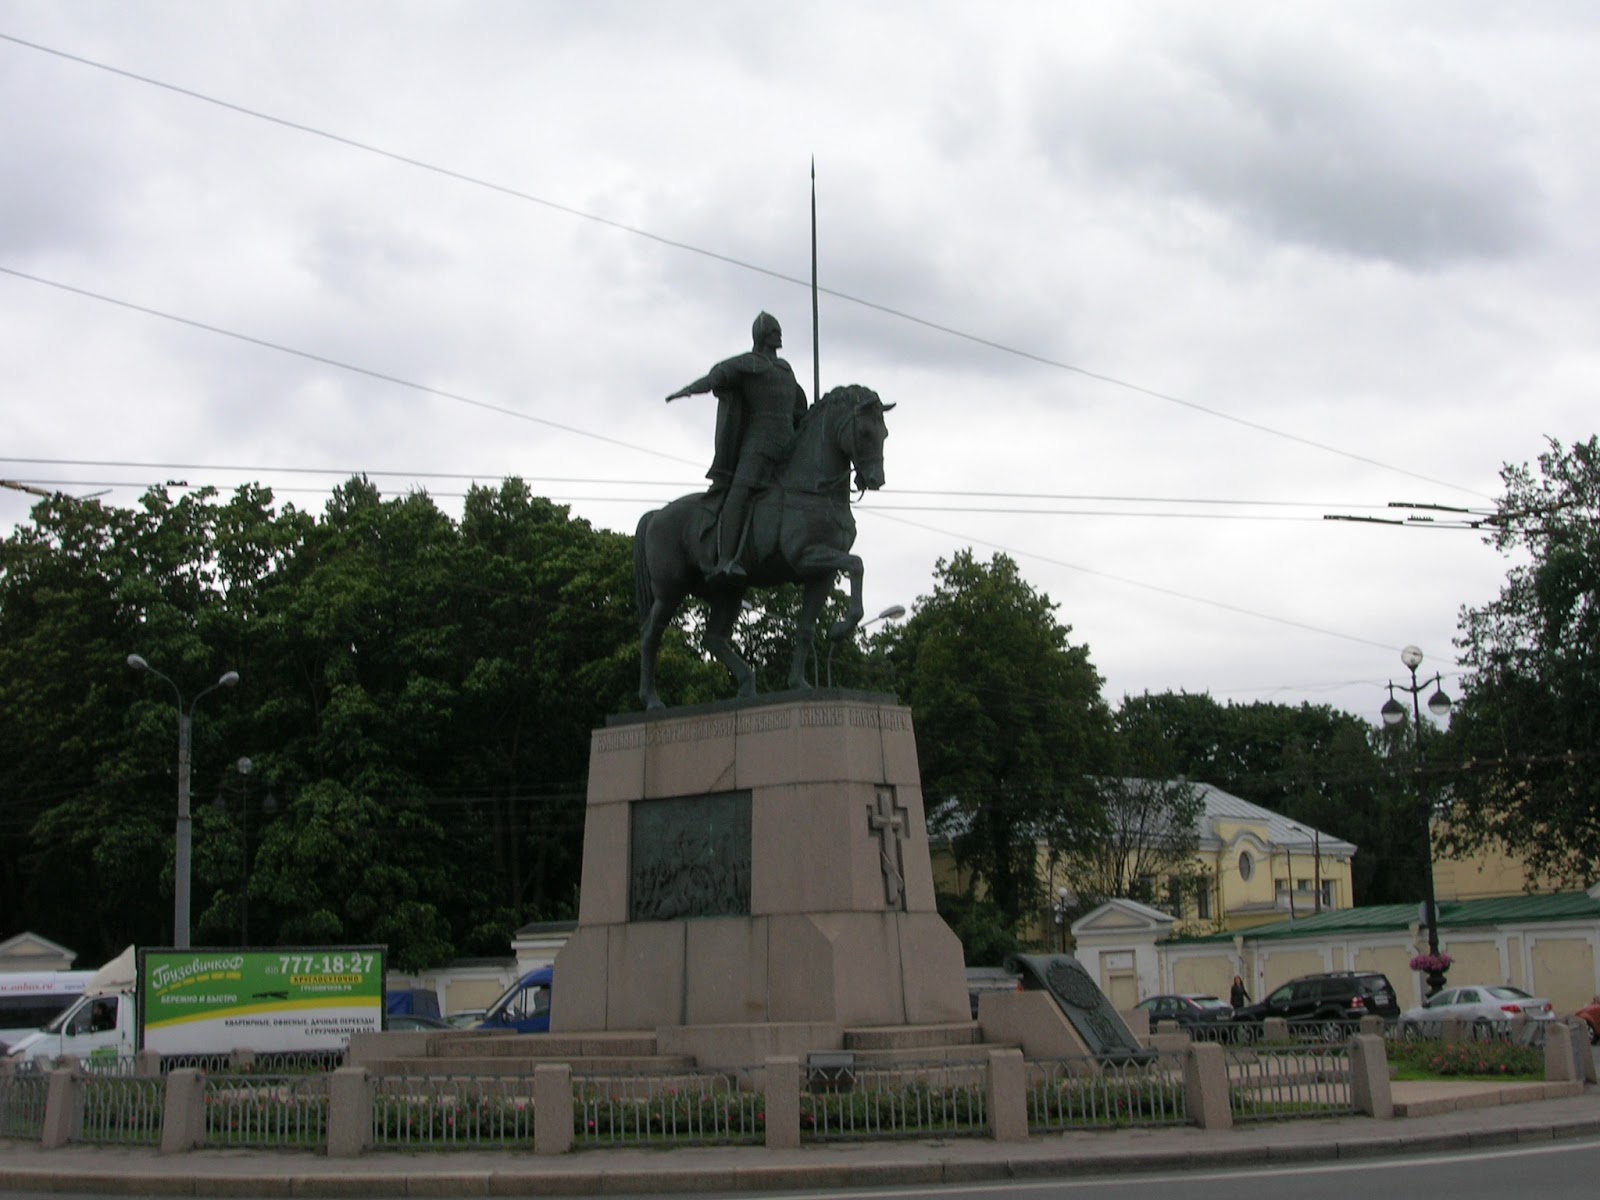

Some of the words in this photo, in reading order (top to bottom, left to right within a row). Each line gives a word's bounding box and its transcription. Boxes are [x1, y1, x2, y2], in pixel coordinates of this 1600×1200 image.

[279, 955, 374, 974] 777-18-27
[293, 975, 360, 983] КРУГЛОСУТОЧНО
[160, 995, 198, 1004] БЕРЕЖНО
[199, 995, 206, 1003] И
[206, 994, 238, 1003] БЫСТРО
[339, 1017, 375, 1025] ПЕРЕЕЗДЫ
